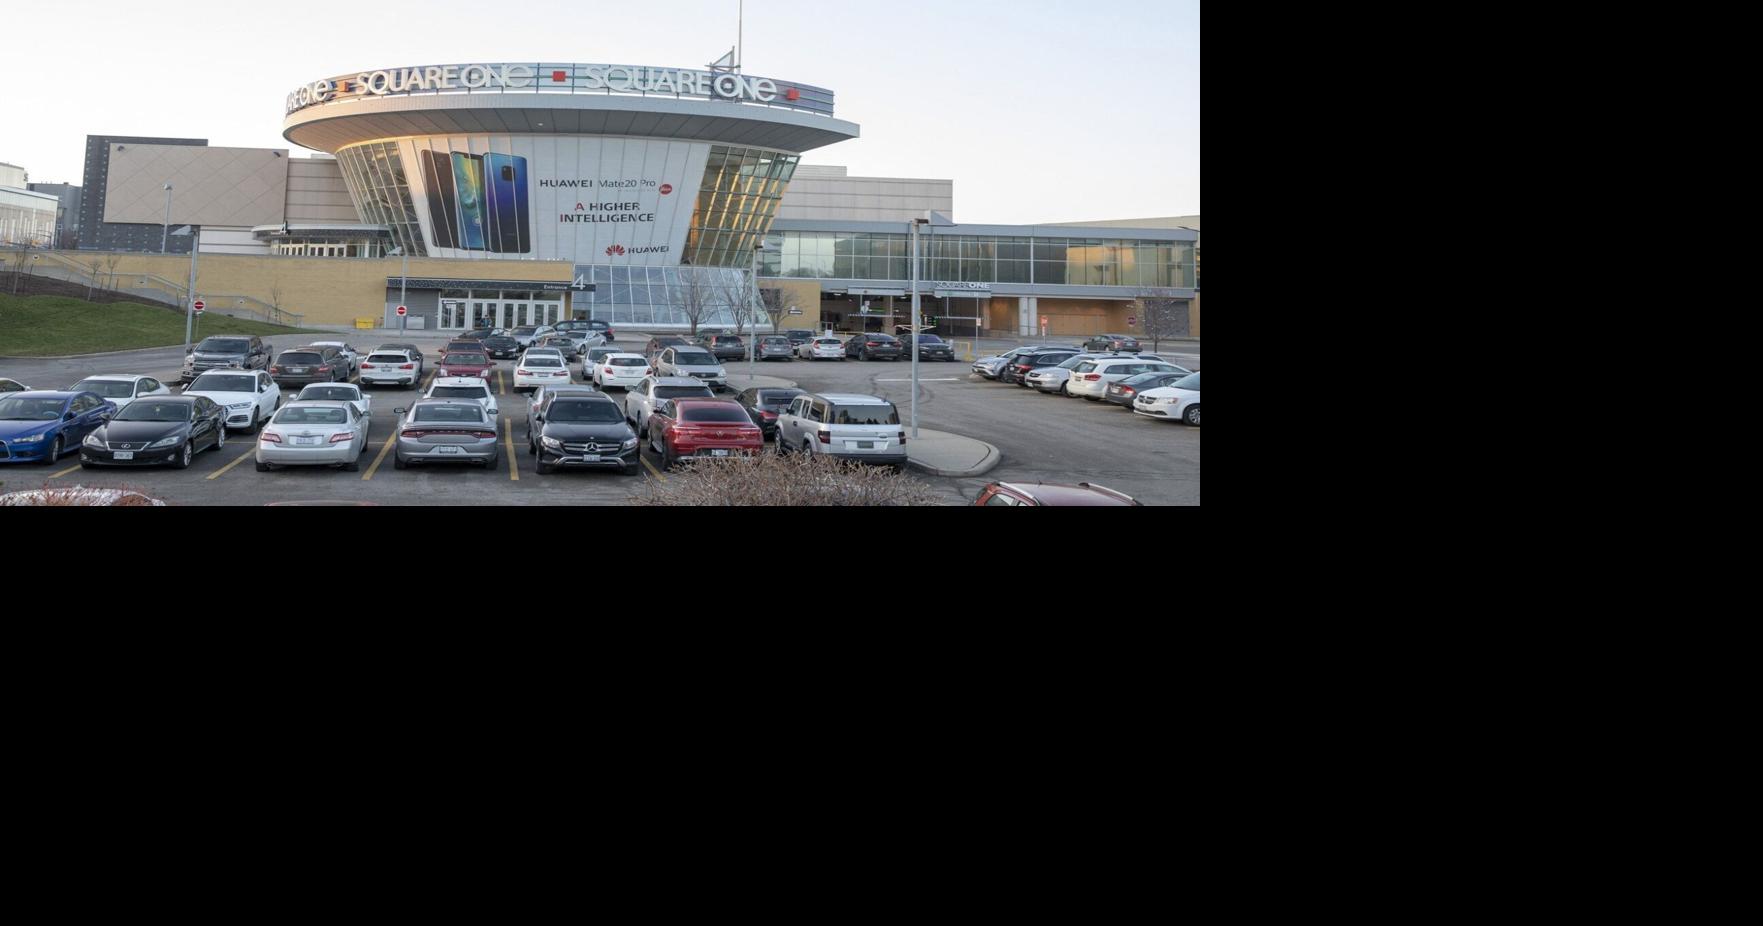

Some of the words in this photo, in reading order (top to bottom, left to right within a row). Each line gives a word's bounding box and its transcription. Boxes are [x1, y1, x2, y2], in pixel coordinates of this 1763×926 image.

[357, 65, 458, 94] SQUARE
[584, 64, 712, 96] SQUARE
[540, 179, 593, 188] HUAWEI
[599, 179, 637, 188] Mate20
[639, 179, 656, 188] Pro
[575, 202, 585, 211] A
[589, 202, 640, 211] HIGHER
[560, 213, 654, 223] INTELLIGENCE
[628, 246, 669, 254] HUAWEI
[570, 273, 586, 290] 4
